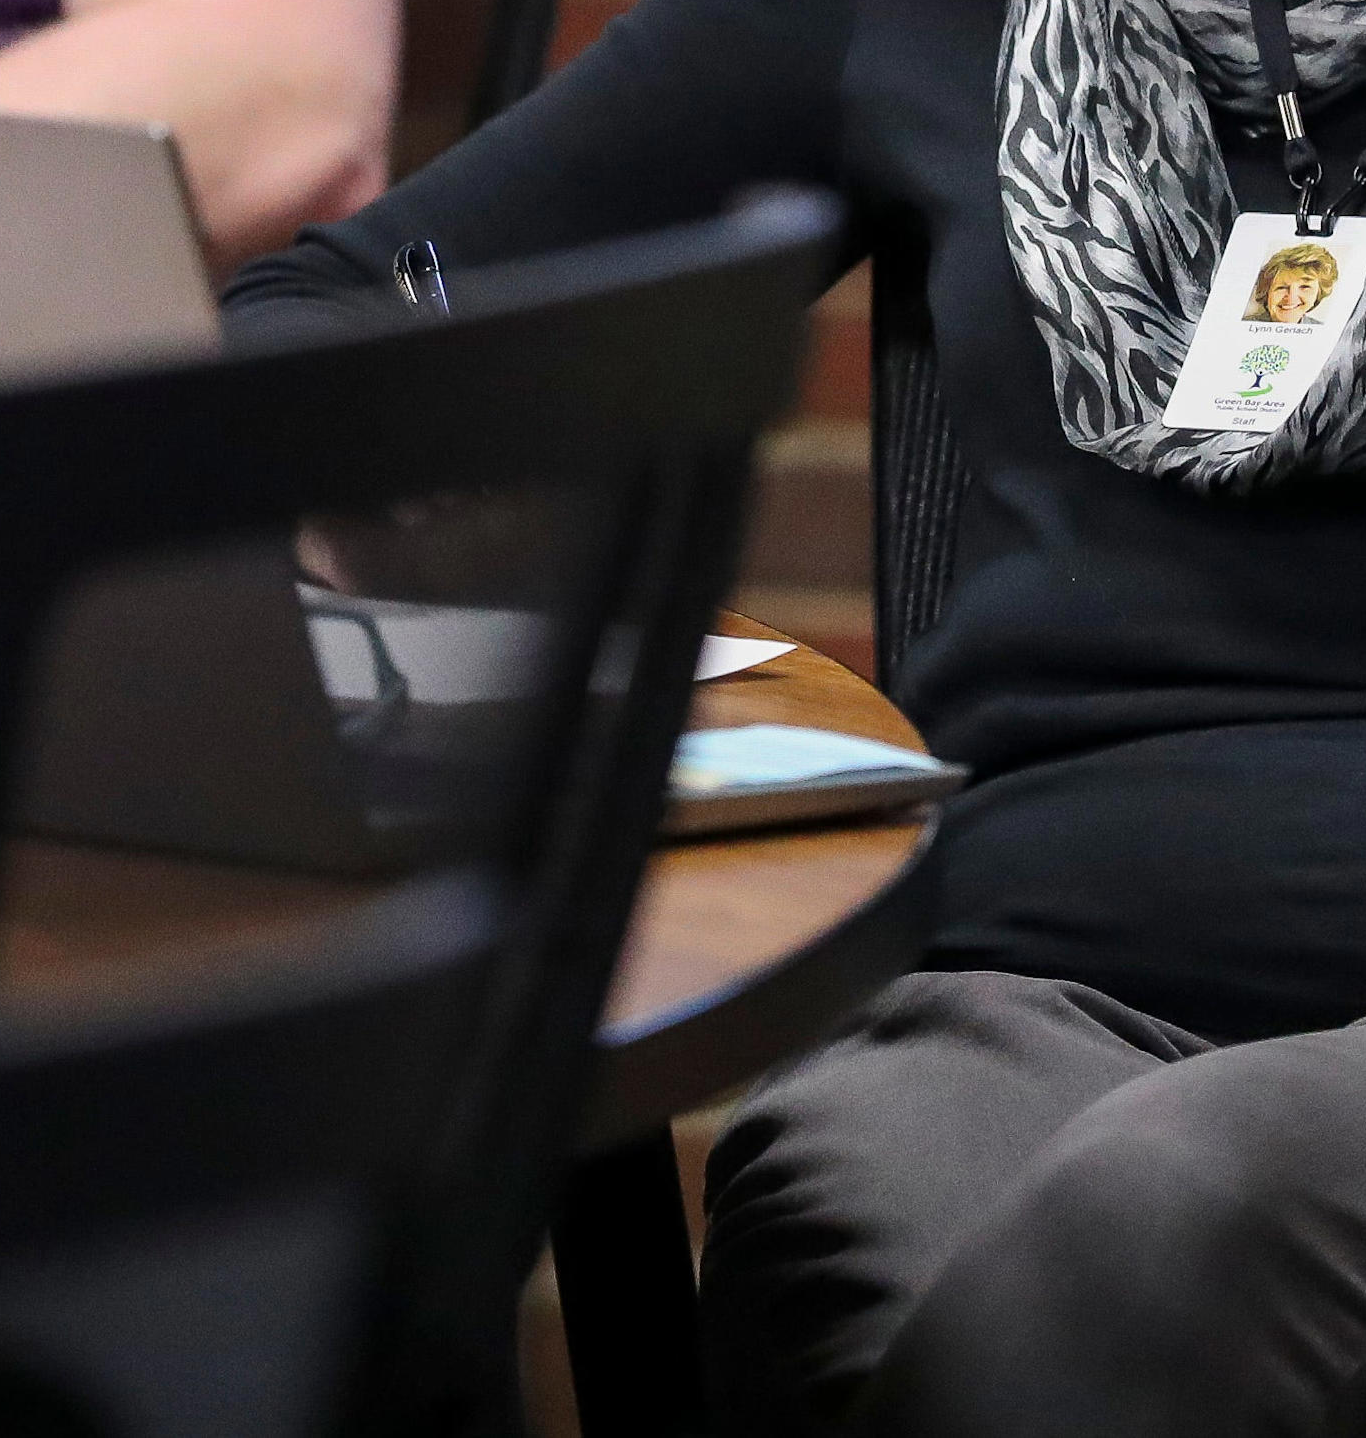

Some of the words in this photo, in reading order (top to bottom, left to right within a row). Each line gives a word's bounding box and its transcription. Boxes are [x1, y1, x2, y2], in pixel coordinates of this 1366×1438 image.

[1249, 324, 1272, 334] Lynn
[1214, 398, 1242, 406] Green
[1232, 417, 1256, 426] Staff
